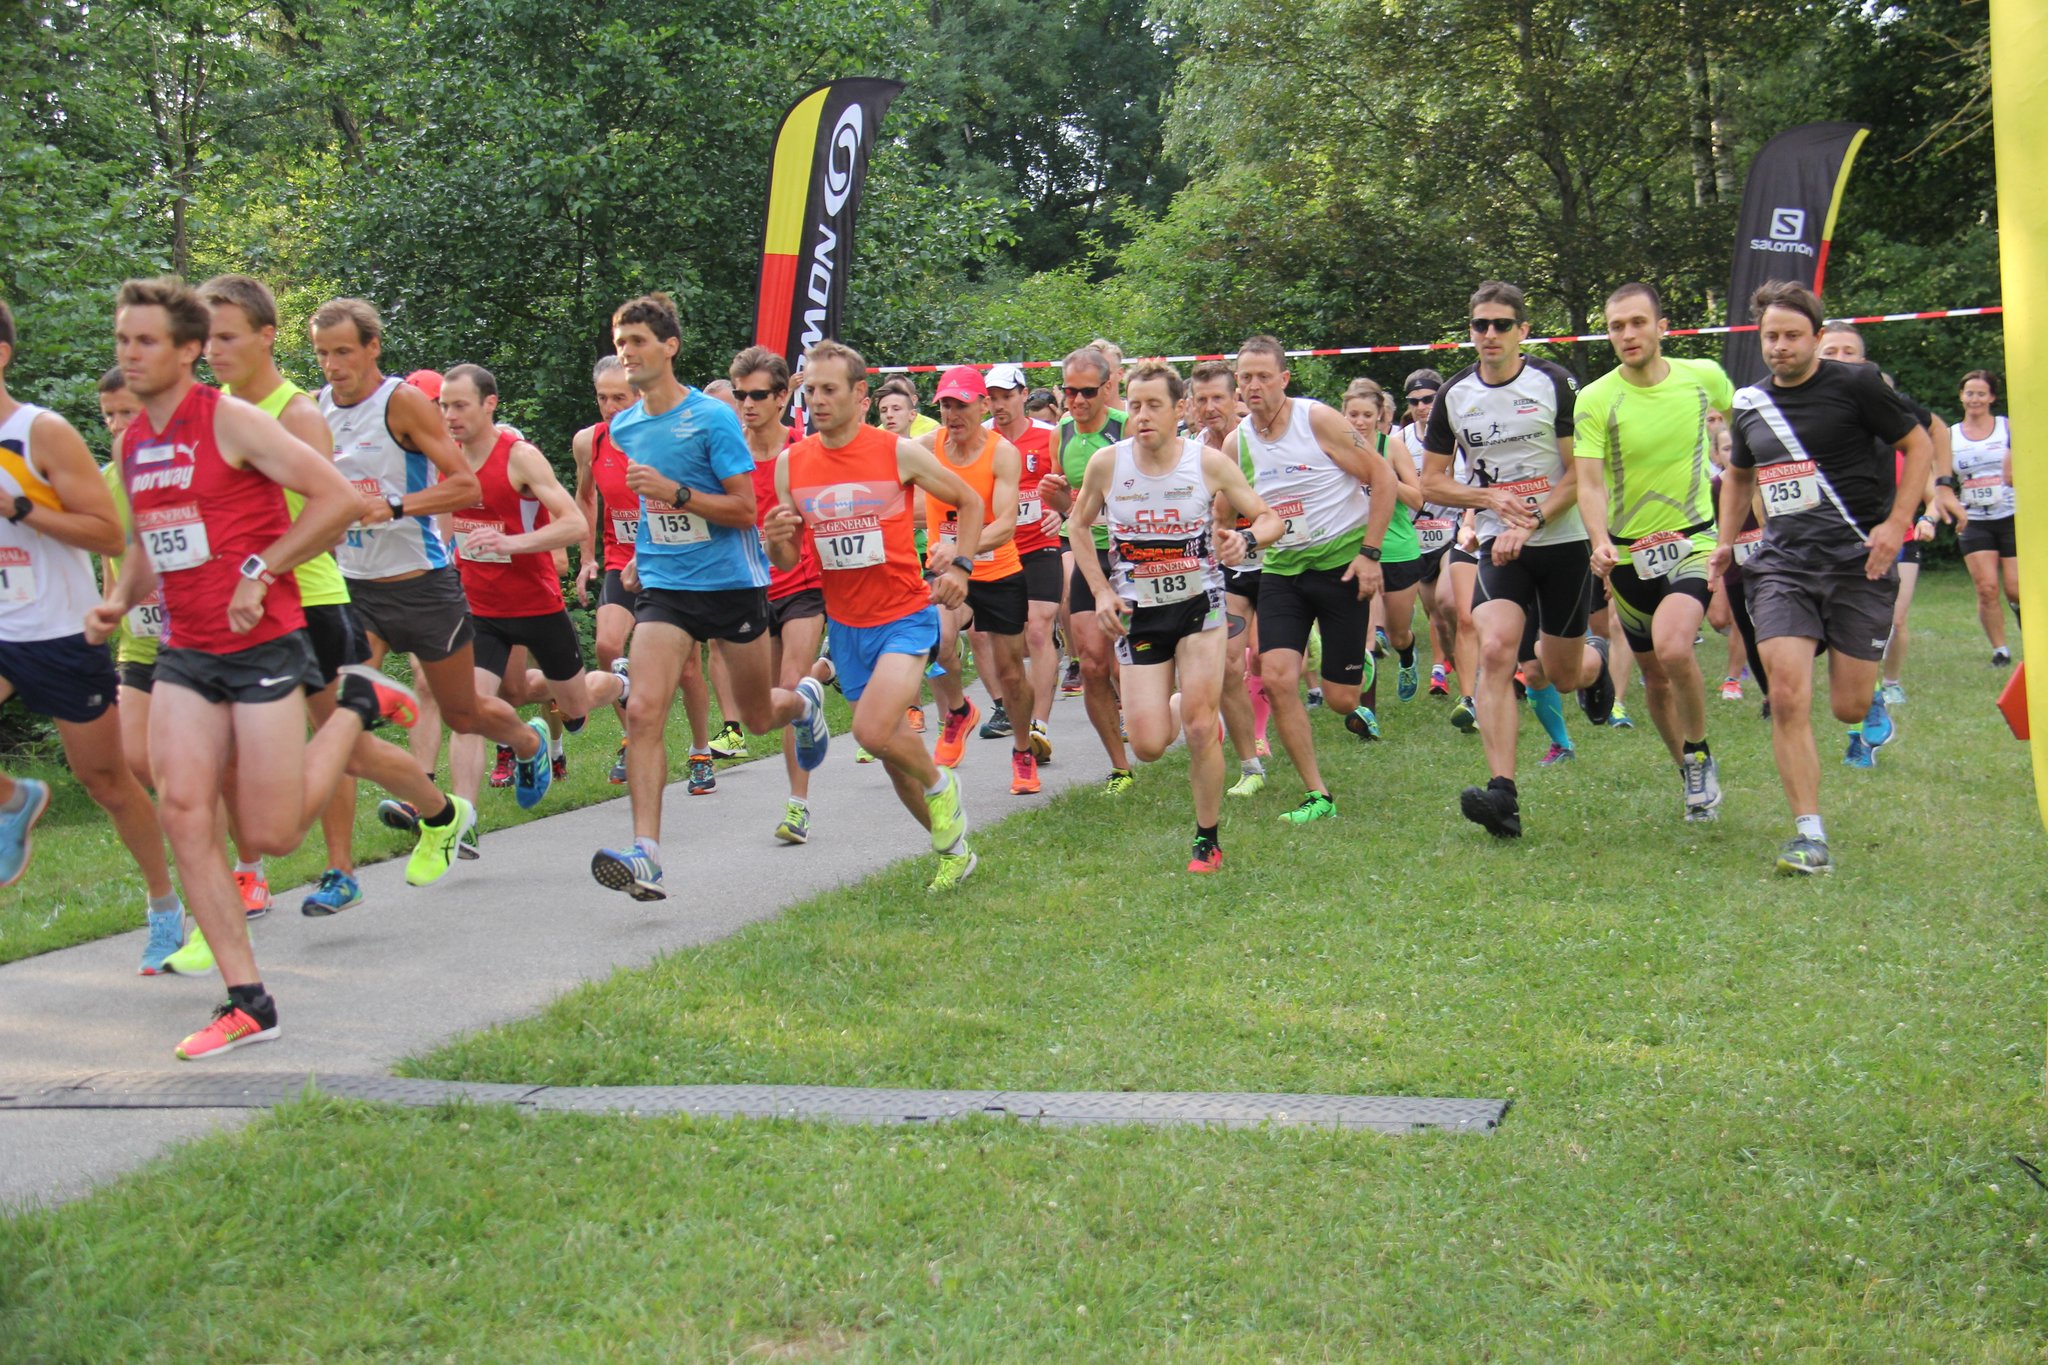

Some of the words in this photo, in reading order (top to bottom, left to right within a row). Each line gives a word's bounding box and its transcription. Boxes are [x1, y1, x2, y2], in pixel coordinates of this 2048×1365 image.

[1750, 239, 1814, 257] salomon
[131, 465, 195, 494] norway
[1769, 480, 1801, 503] 253
[1971, 487, 1993, 499] 159
[658, 514, 692, 534] 153
[826, 515, 879, 534] GENERALI
[150, 528, 188, 556] 255
[1422, 529, 1444, 542] 200
[828, 535, 866, 557] 107
[1645, 543, 1679, 567] 210
[1148, 558, 1198, 574] GENERALI
[1150, 575, 1187, 595] 183
